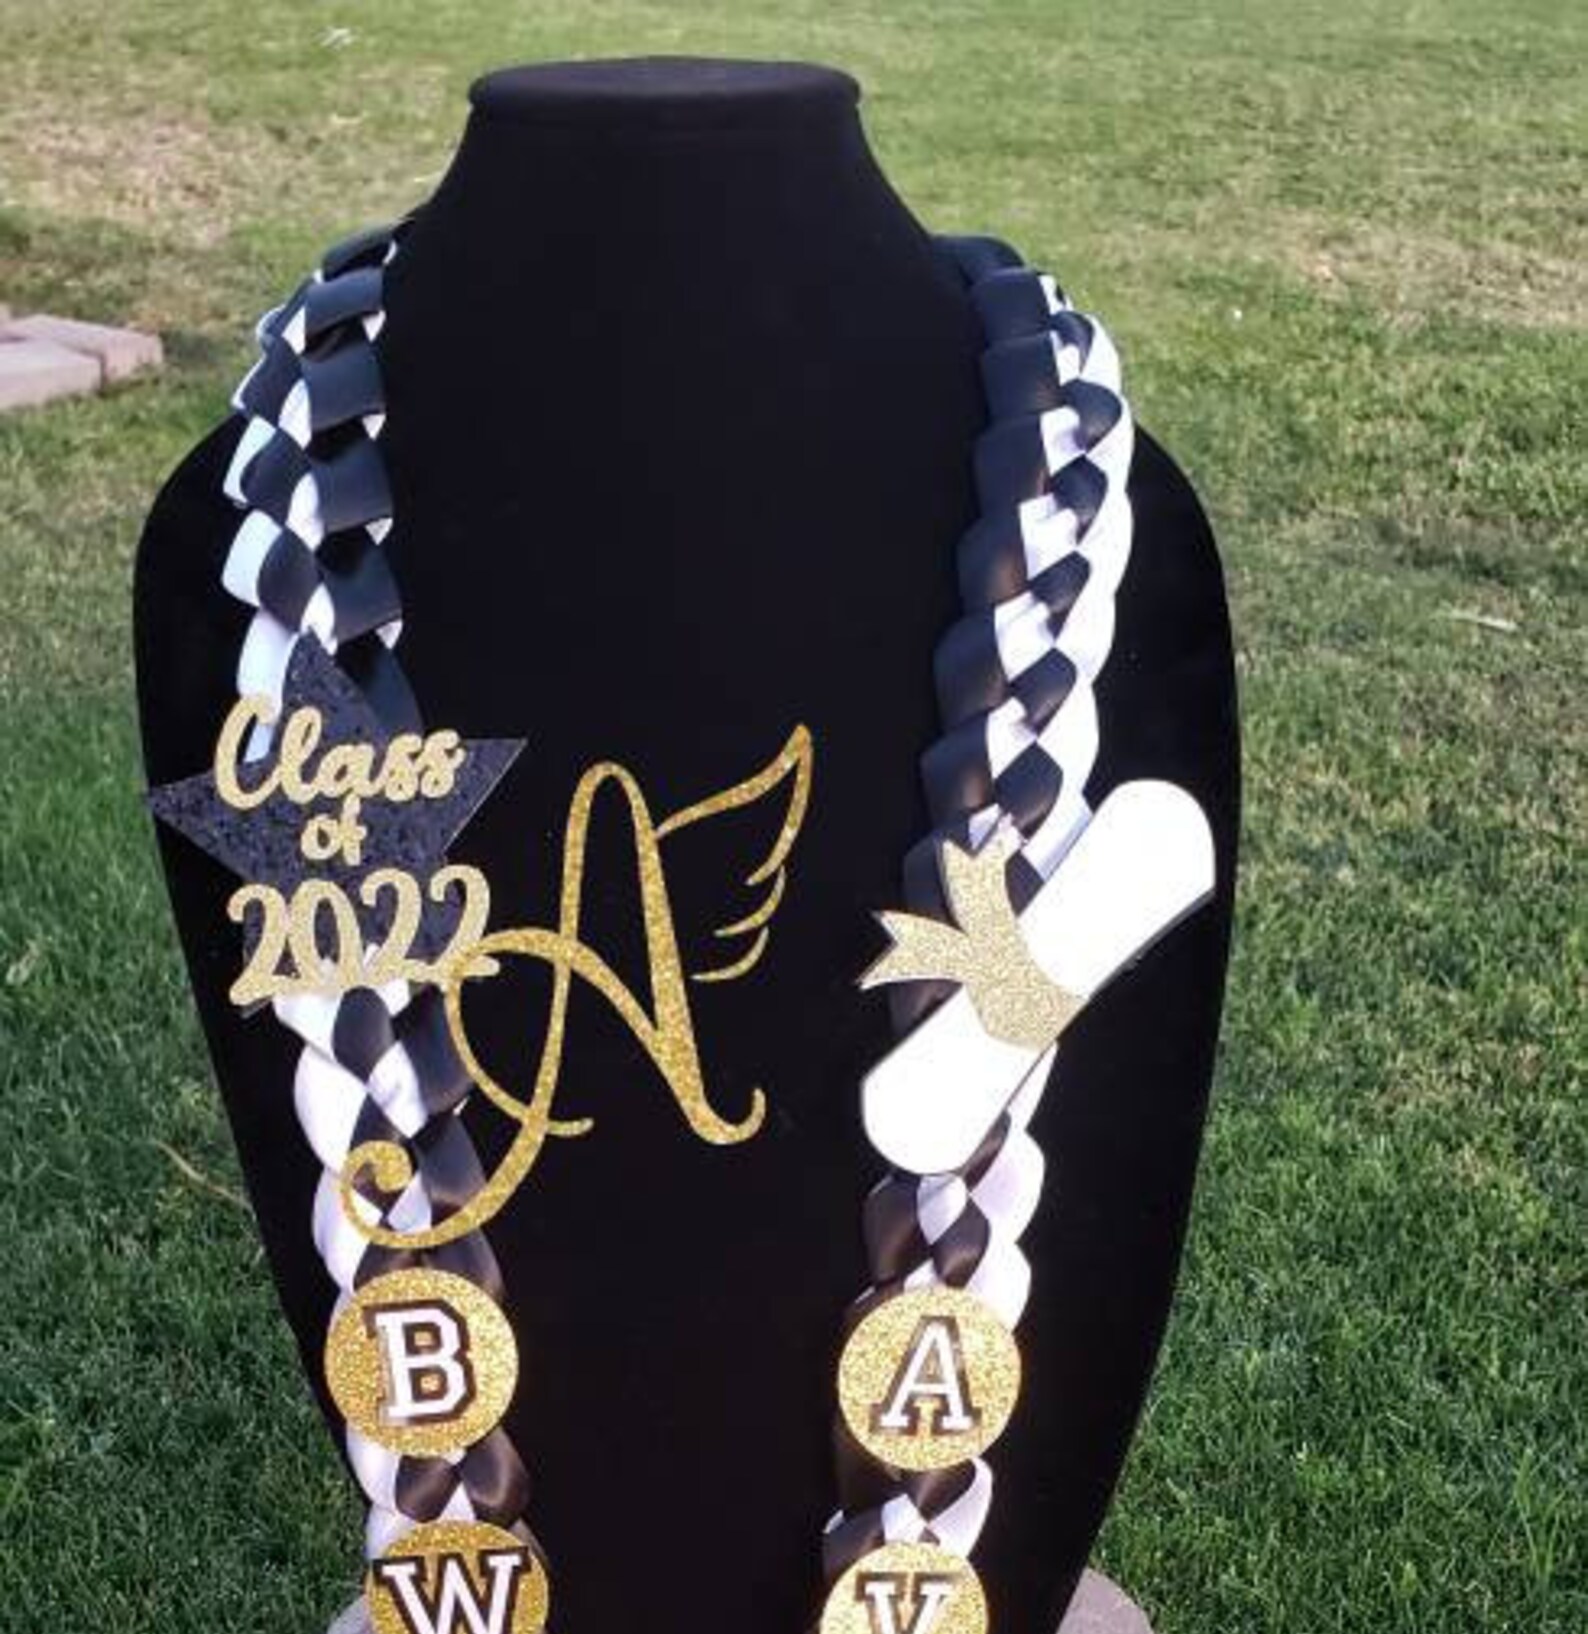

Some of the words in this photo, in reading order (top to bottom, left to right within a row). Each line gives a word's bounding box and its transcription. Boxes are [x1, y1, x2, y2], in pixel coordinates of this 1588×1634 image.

[214, 694, 467, 810] Class
[301, 797, 367, 865] of
[227, 864, 500, 1007] 2022
